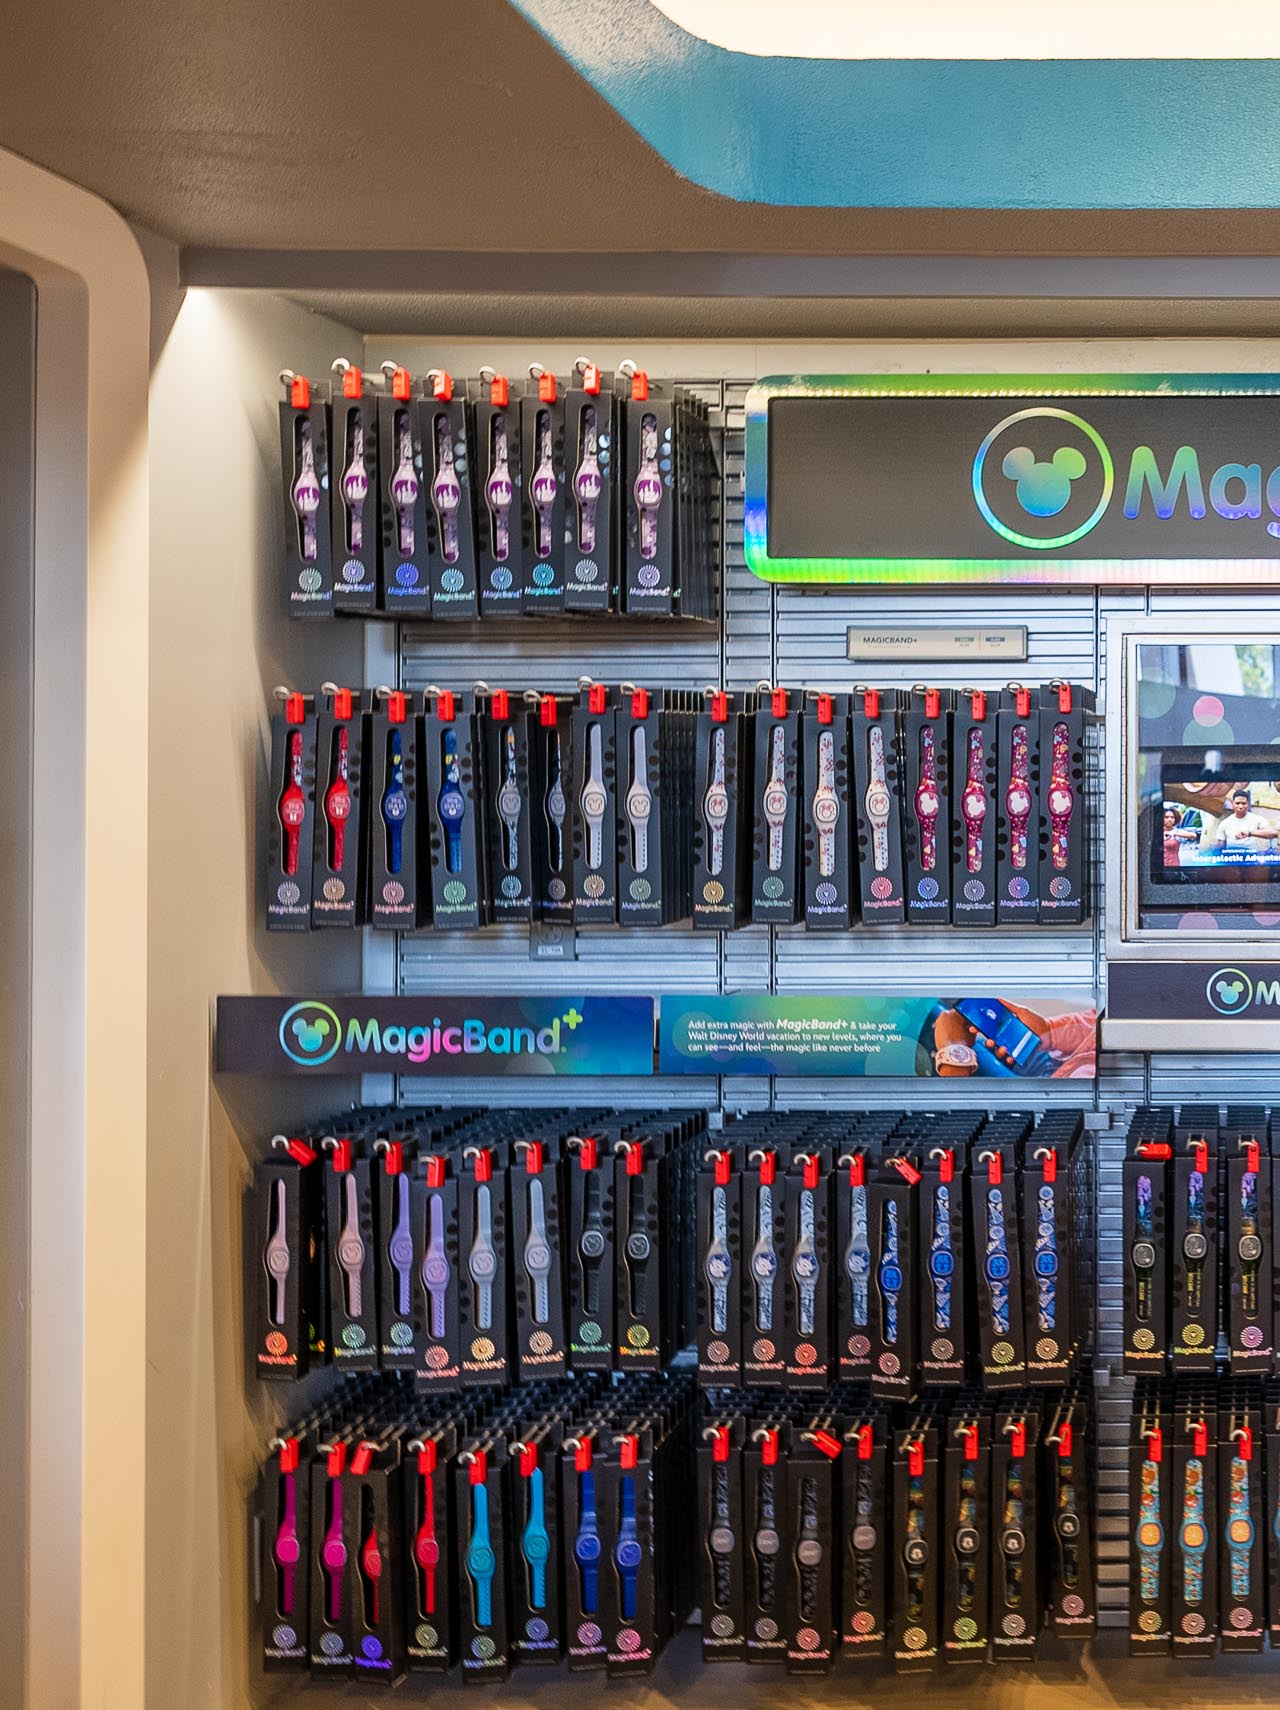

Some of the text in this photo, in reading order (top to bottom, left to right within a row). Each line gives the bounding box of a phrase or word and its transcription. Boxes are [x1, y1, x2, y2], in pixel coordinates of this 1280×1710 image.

[863, 636, 918, 644] MAGICBAND+
[688, 1020, 706, 1030] Add
[707, 1021, 729, 1030] extra
[730, 1020, 755, 1031] magic
[756, 1020, 775, 1030] with
[850, 1021, 857, 1030] &
[858, 1021, 877, 1030] take
[878, 1023, 897, 1032] your
[688, 1031, 708, 1040] Walt
[710, 1031, 738, 1042] Disney
[739, 1031, 765, 1041] World
[766, 1032, 800, 1041] vacation
[802, 1033, 811, 1041] to
[832, 1032, 858, 1042] levels,
[859, 1032, 885, 1041] where
[886, 1034, 902, 1043] you
[688, 1044, 703, 1052] can
[786, 1043, 811, 1054] magic
[812, 1043, 828, 1052] like
[829, 1044, 852, 1052] never
[853, 1043, 881, 1052] before
